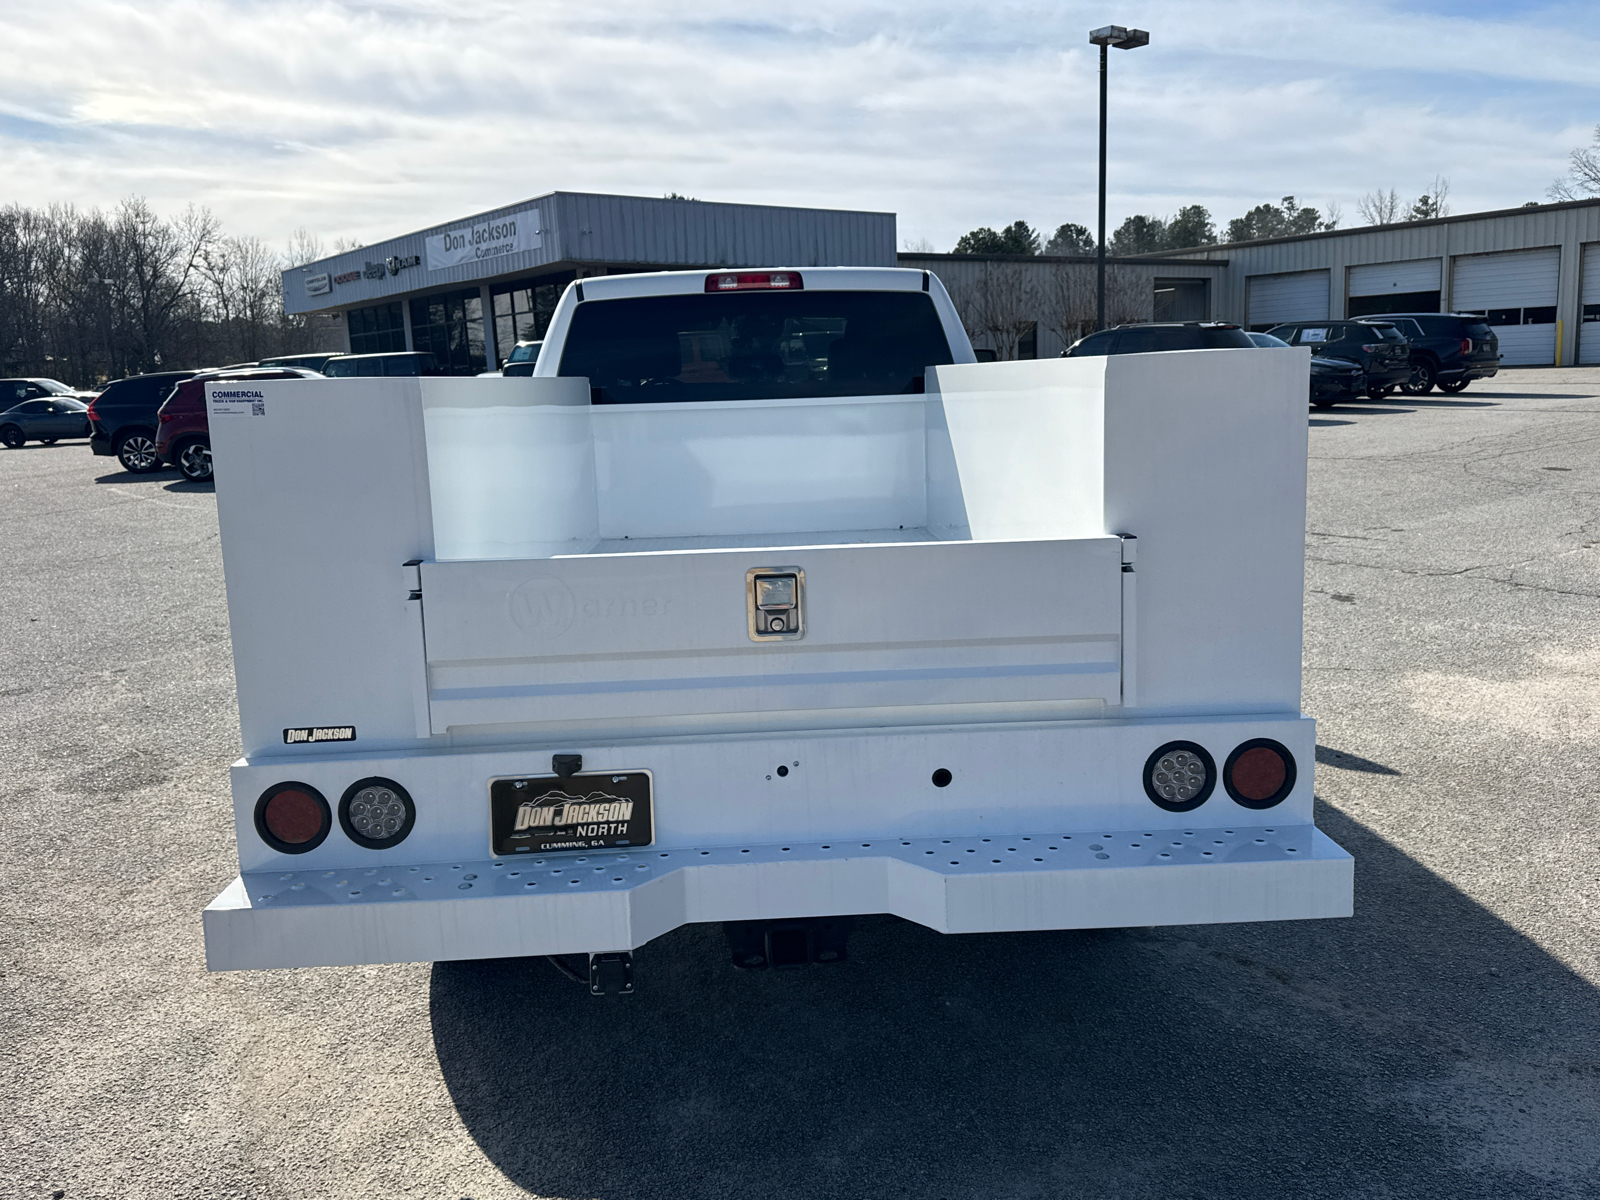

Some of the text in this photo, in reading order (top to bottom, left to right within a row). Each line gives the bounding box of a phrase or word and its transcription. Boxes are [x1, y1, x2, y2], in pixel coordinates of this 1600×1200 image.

[443, 221, 516, 252] Don Jackson
[475, 242, 513, 259] Commerce
[211, 390, 264, 398] COMMERCIAL
[286, 728, 353, 743] DON JACKSON
[514, 802, 634, 830] DON JACKSON
[576, 823, 628, 837] NORTH
[540, 840, 589, 850] CUMMING,
